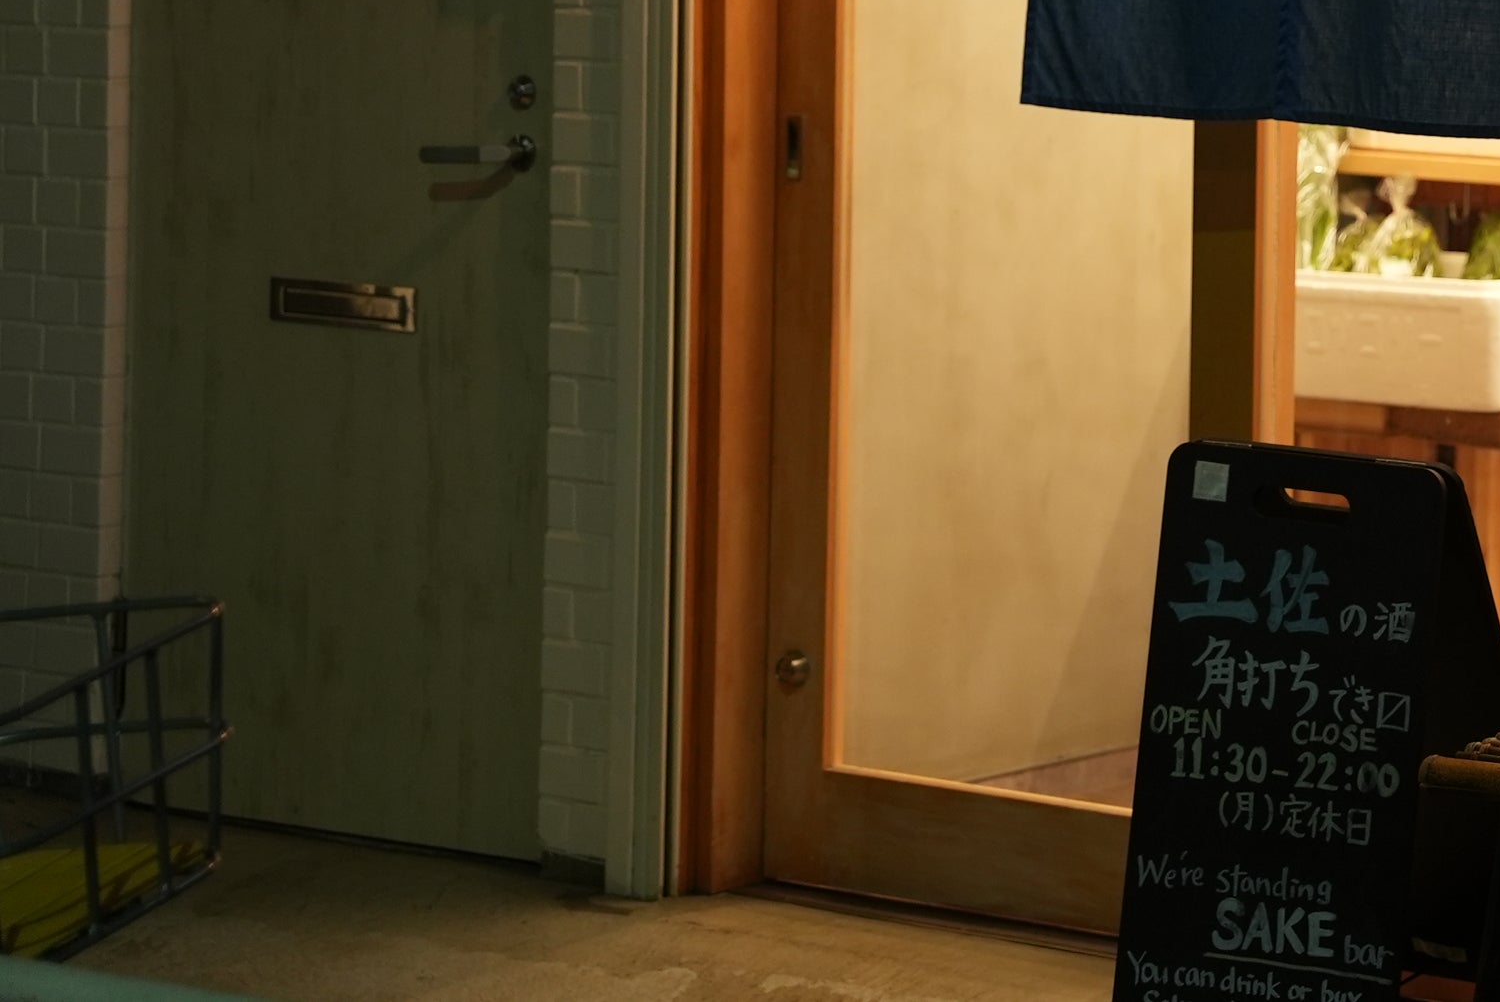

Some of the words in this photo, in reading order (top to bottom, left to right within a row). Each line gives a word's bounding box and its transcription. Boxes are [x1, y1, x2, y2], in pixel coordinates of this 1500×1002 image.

[1168, 538, 1416, 644] 土佐の酒
[1150, 704, 1222, 739] OPEN
[1291, 720, 1379, 753] CLOSE
[1136, 850, 1204, 889] We're
[1215, 864, 1333, 905] standing
[1211, 897, 1337, 958] SAKE
[1343, 934, 1395, 970] bar
[1126, 950, 1168, 986] You
[1173, 964, 1215, 988] can
[1219, 966, 1281, 1002] drink
[1287, 984, 1313, 1000] or
